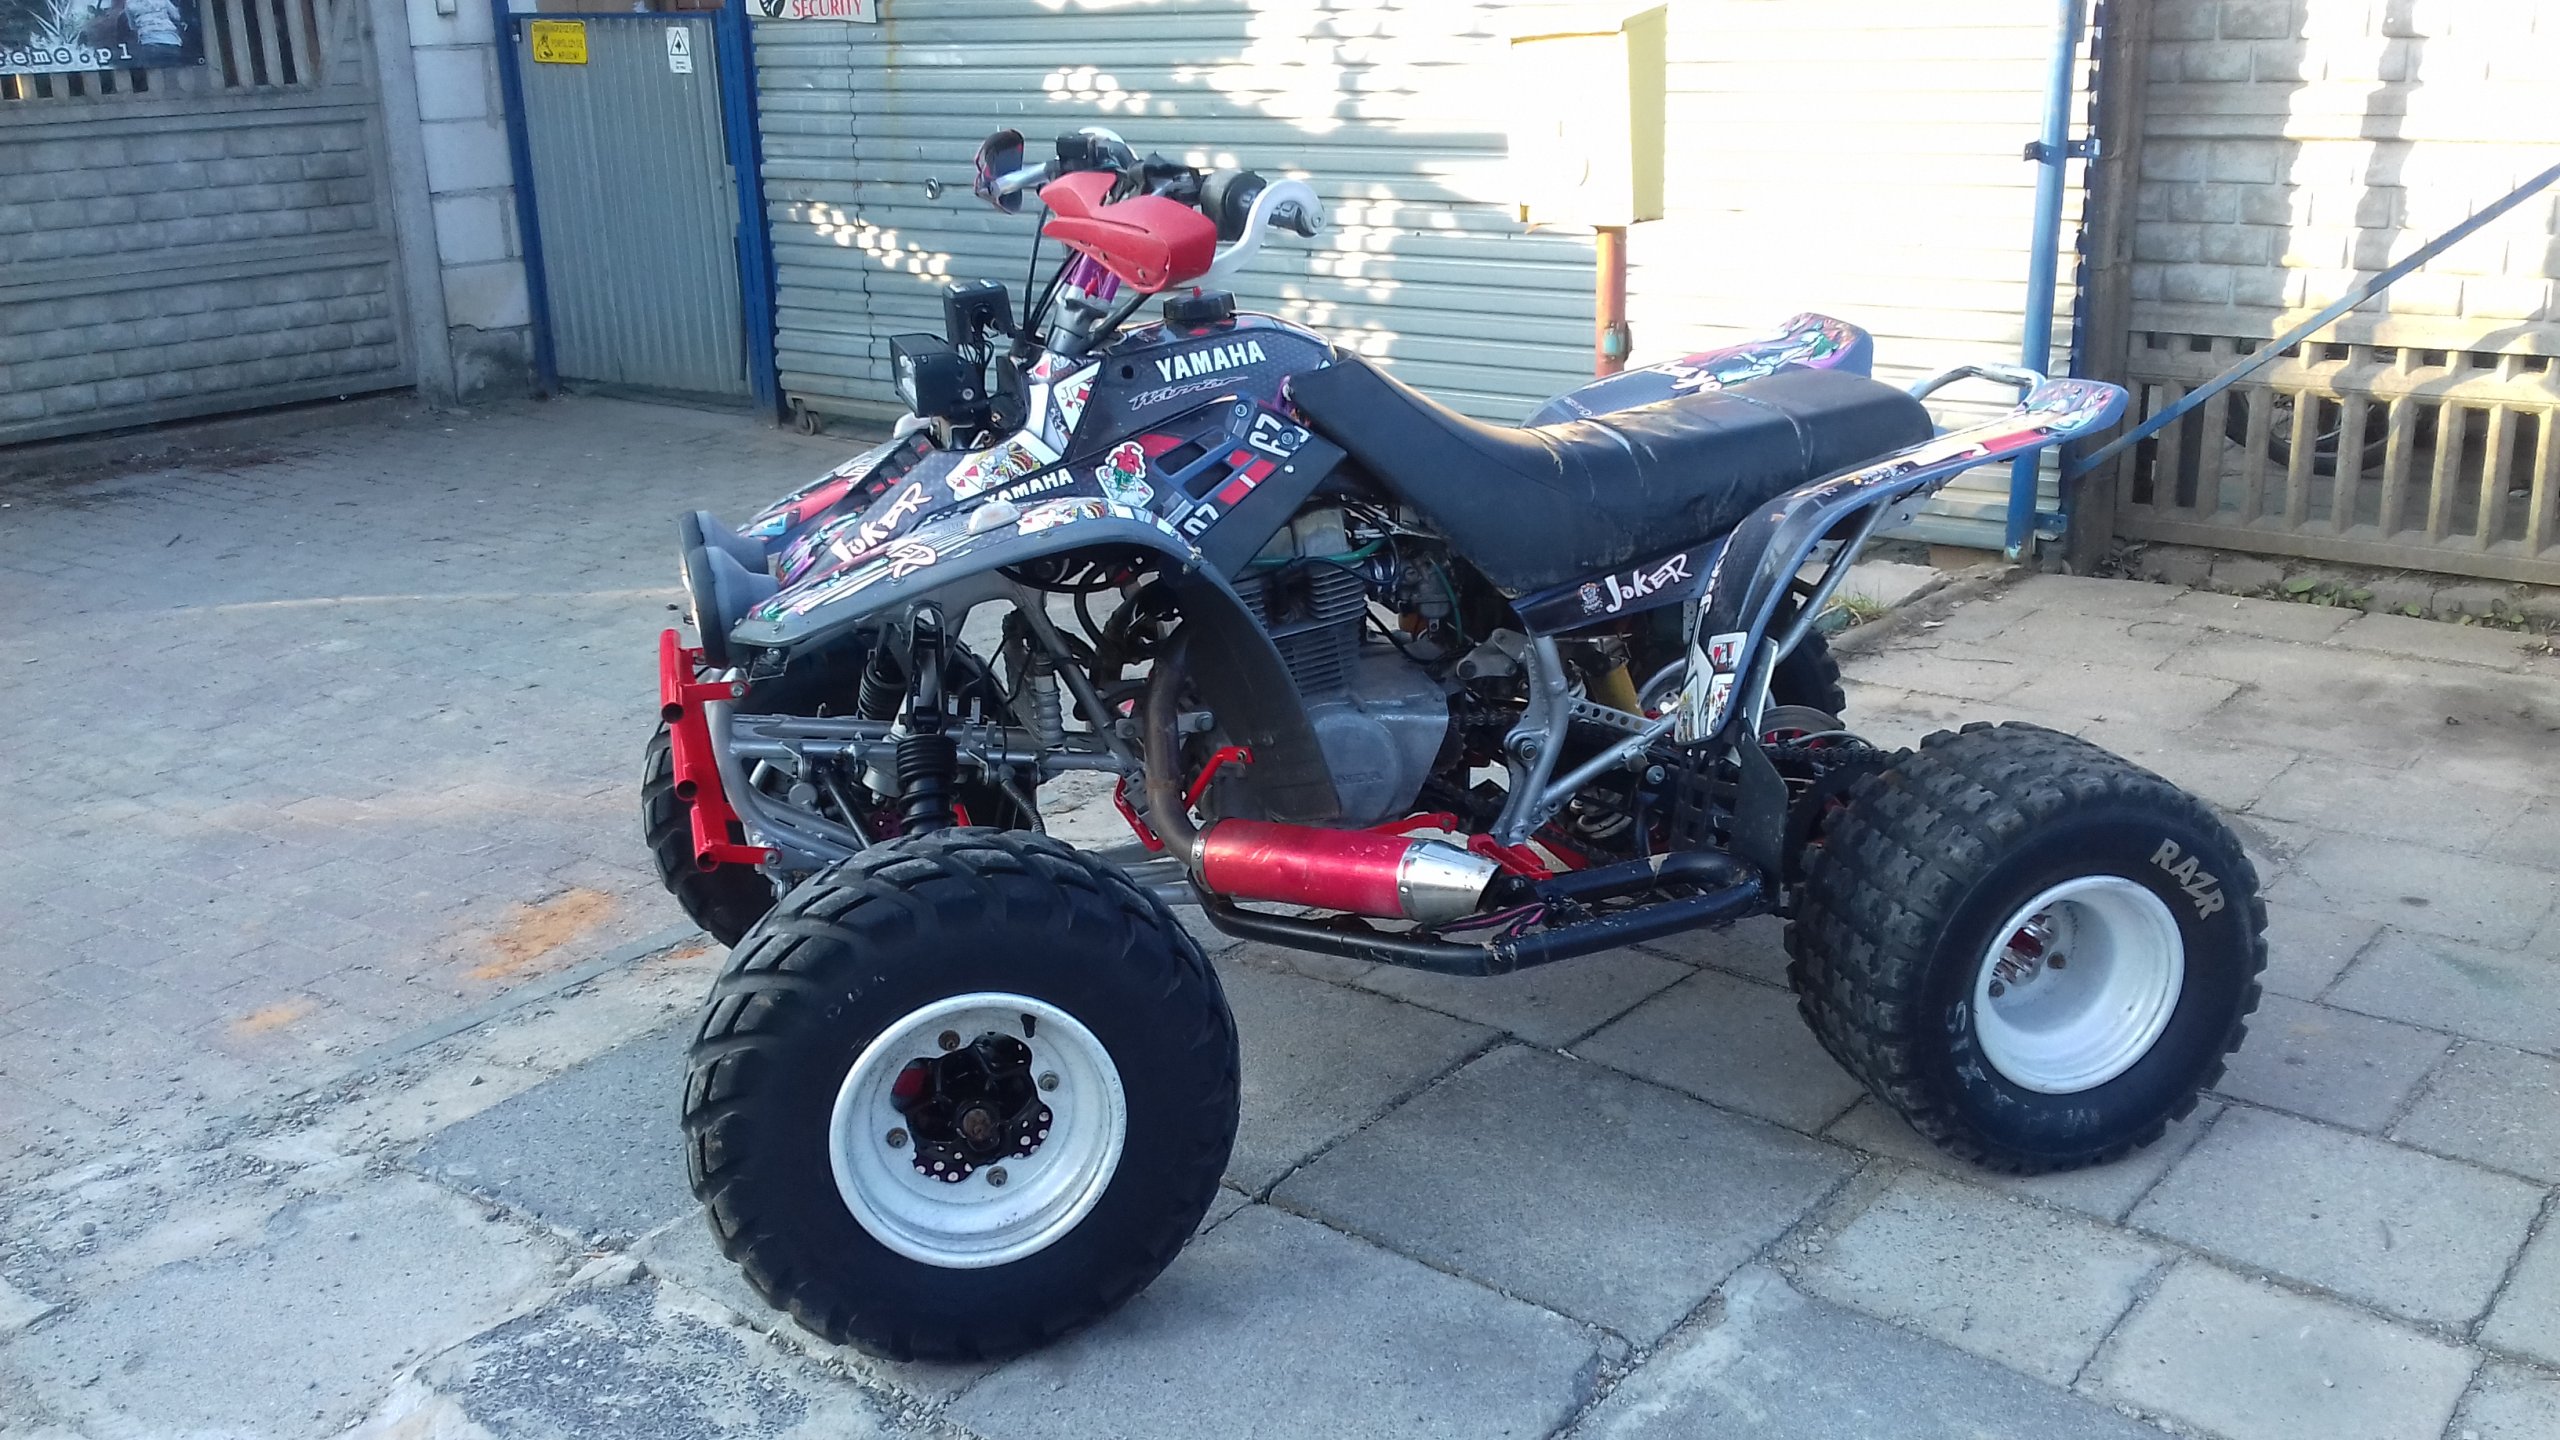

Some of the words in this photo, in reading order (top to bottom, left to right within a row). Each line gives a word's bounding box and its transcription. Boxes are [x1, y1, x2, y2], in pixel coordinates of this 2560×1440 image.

[792, 0, 862, 16] SECURITY
[1155, 340, 1266, 382] YAMAHA
[2150, 838, 2225, 920] RAZR
